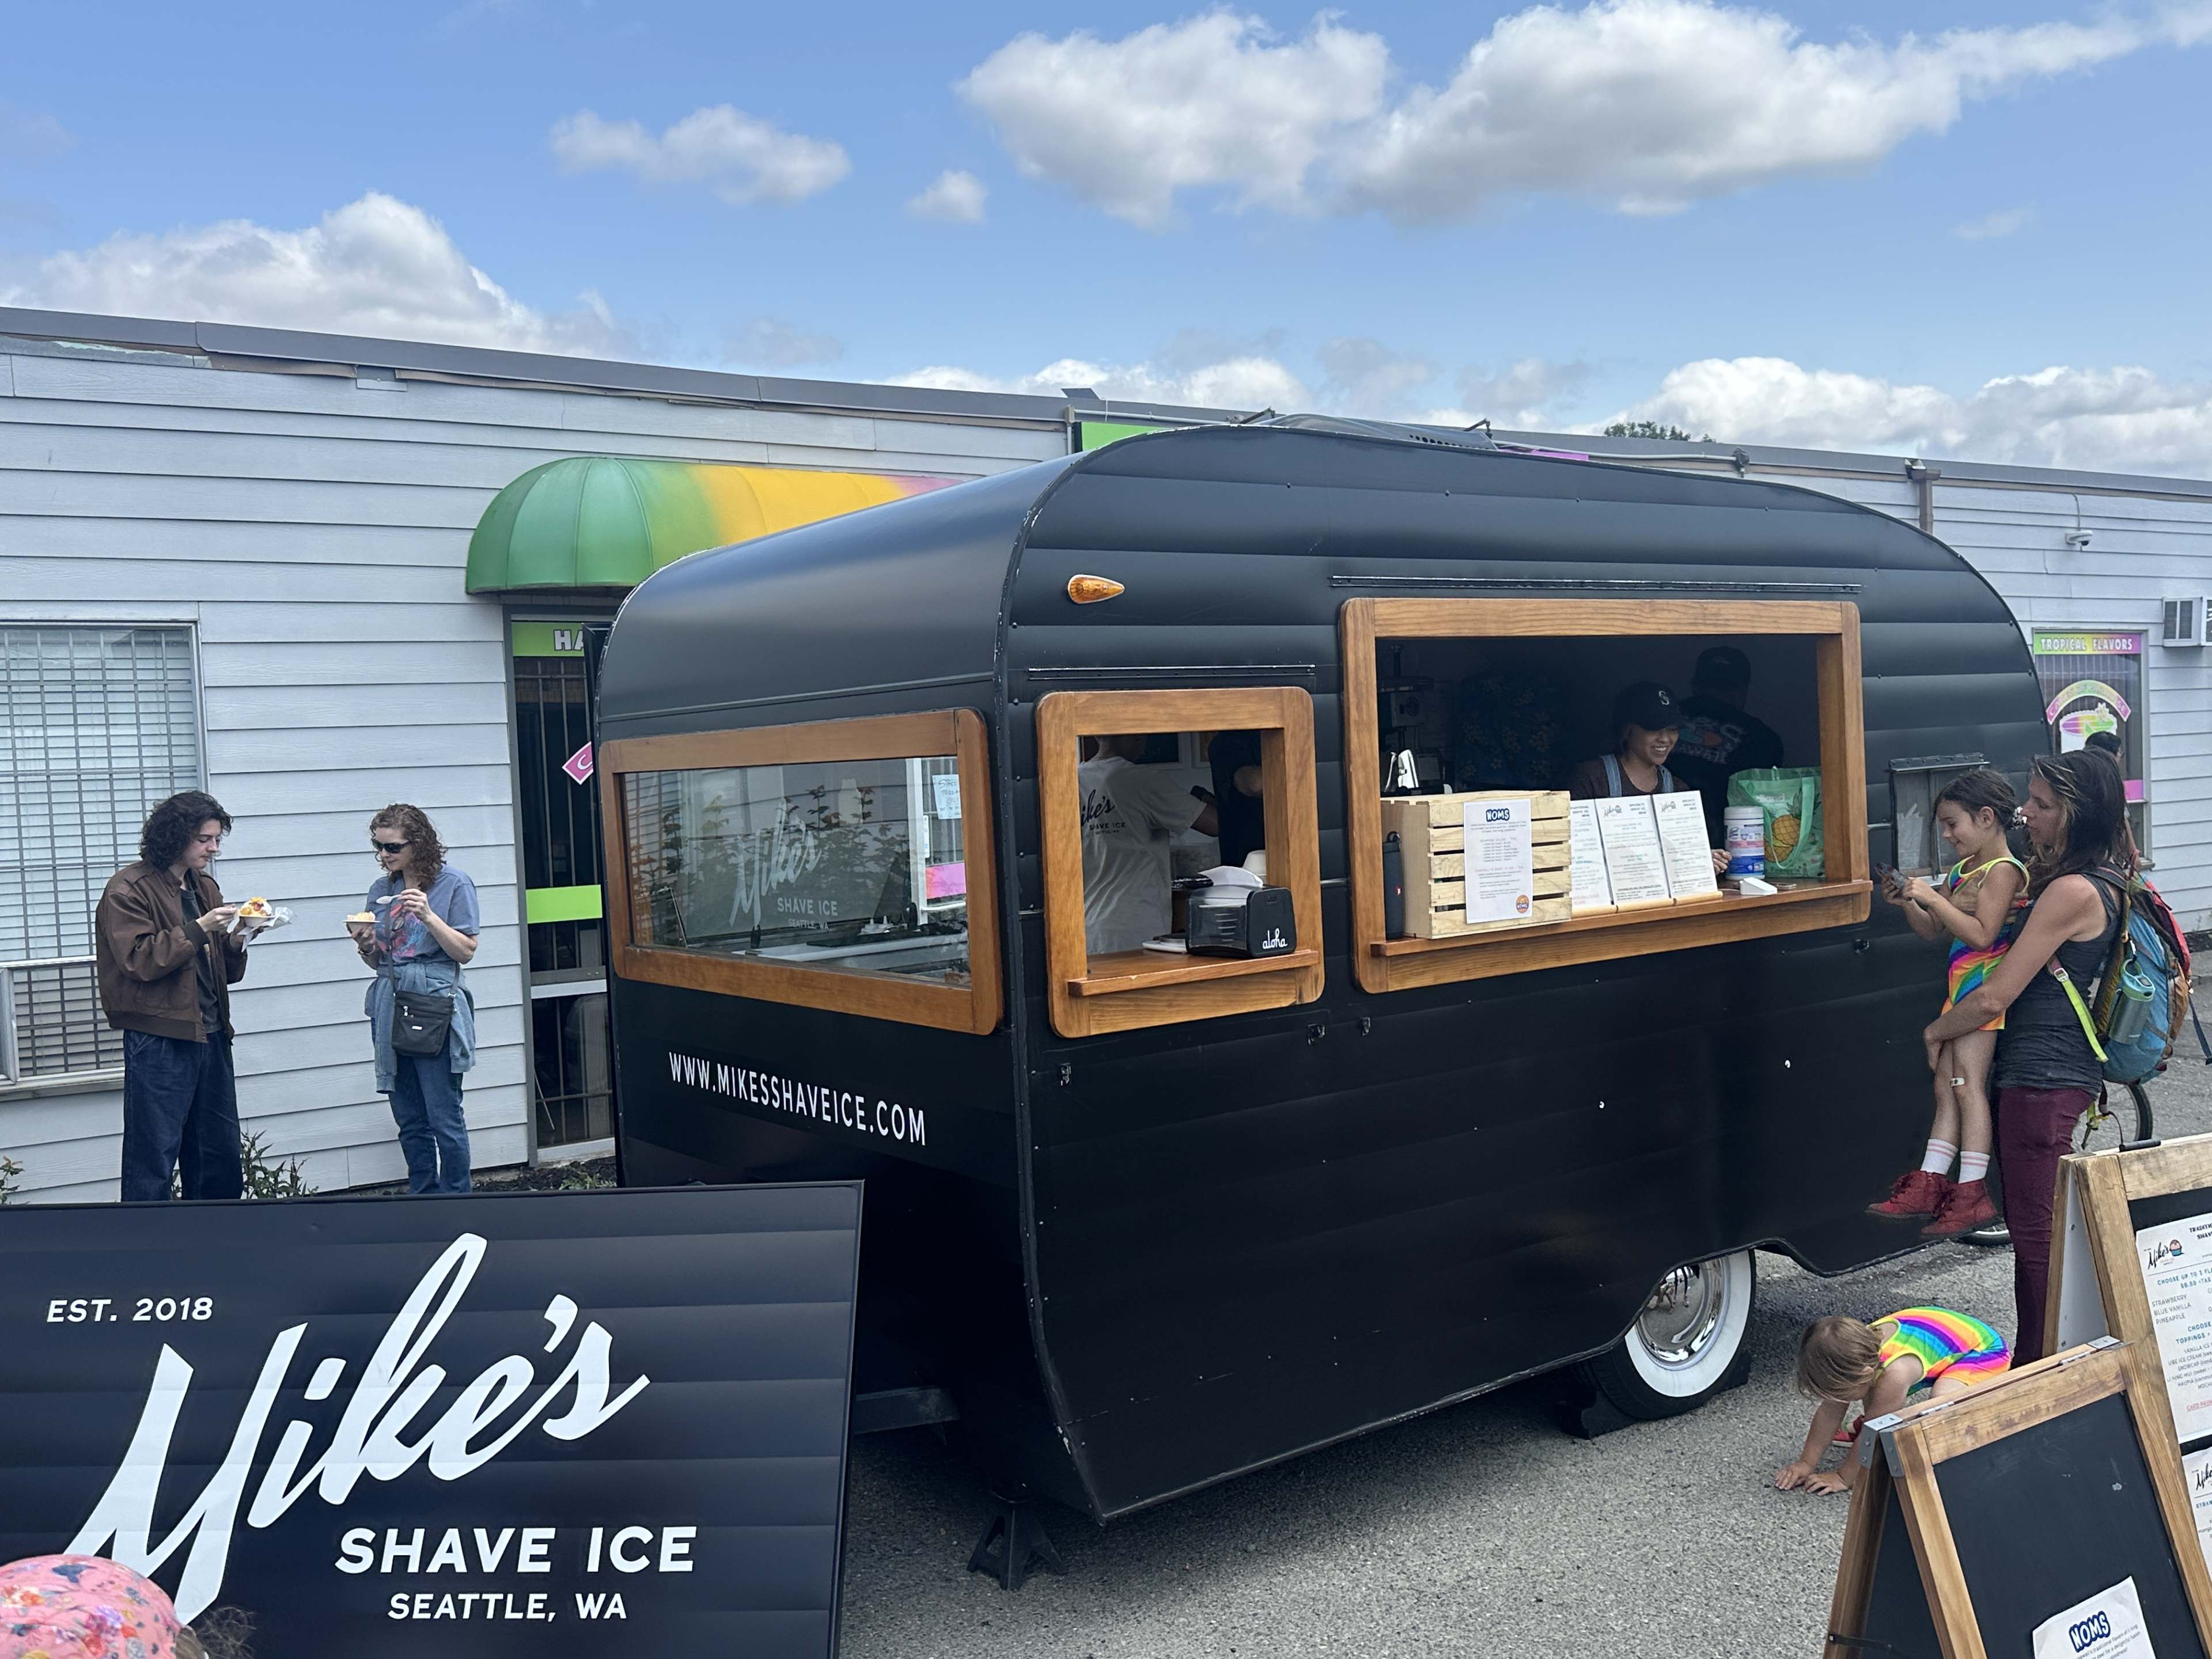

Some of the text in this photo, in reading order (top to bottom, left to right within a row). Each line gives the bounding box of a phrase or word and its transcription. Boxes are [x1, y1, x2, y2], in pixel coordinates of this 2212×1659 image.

[2040, 637, 2133, 651] TROPICAL FLAVORS
[1081, 789, 1115, 827] ike's
[1486, 808, 1510, 822] NOMS
[729, 797, 822, 930] Mike's
[778, 897, 838, 916] SHAVE ICE
[1262, 928, 1288, 949] aloha
[669, 1052, 925, 1145] WWW.MIKESSHAVEICE.COM
[2148, 1242, 2169, 1270] Mike's
[2157, 1275, 2179, 1285] CHOOSE
[47, 1297, 213, 1322] EST. 2018
[2152, 1294, 2187, 1307] STRAWBERRY
[2154, 1302, 2191, 1316] BLUE VANILLA
[2156, 1313, 2186, 1324] PINEAPPLE
[2188, 1321, 2211, 1332] CHOOSE
[2176, 1332, 2206, 1344] TOPPINGS
[63, 1233, 650, 1626] Mike's
[335, 1527, 696, 1573] SHAVE ICE
[389, 1592, 627, 1620] SEATTLE, WA
[2069, 1611, 2111, 1652] NOMS
